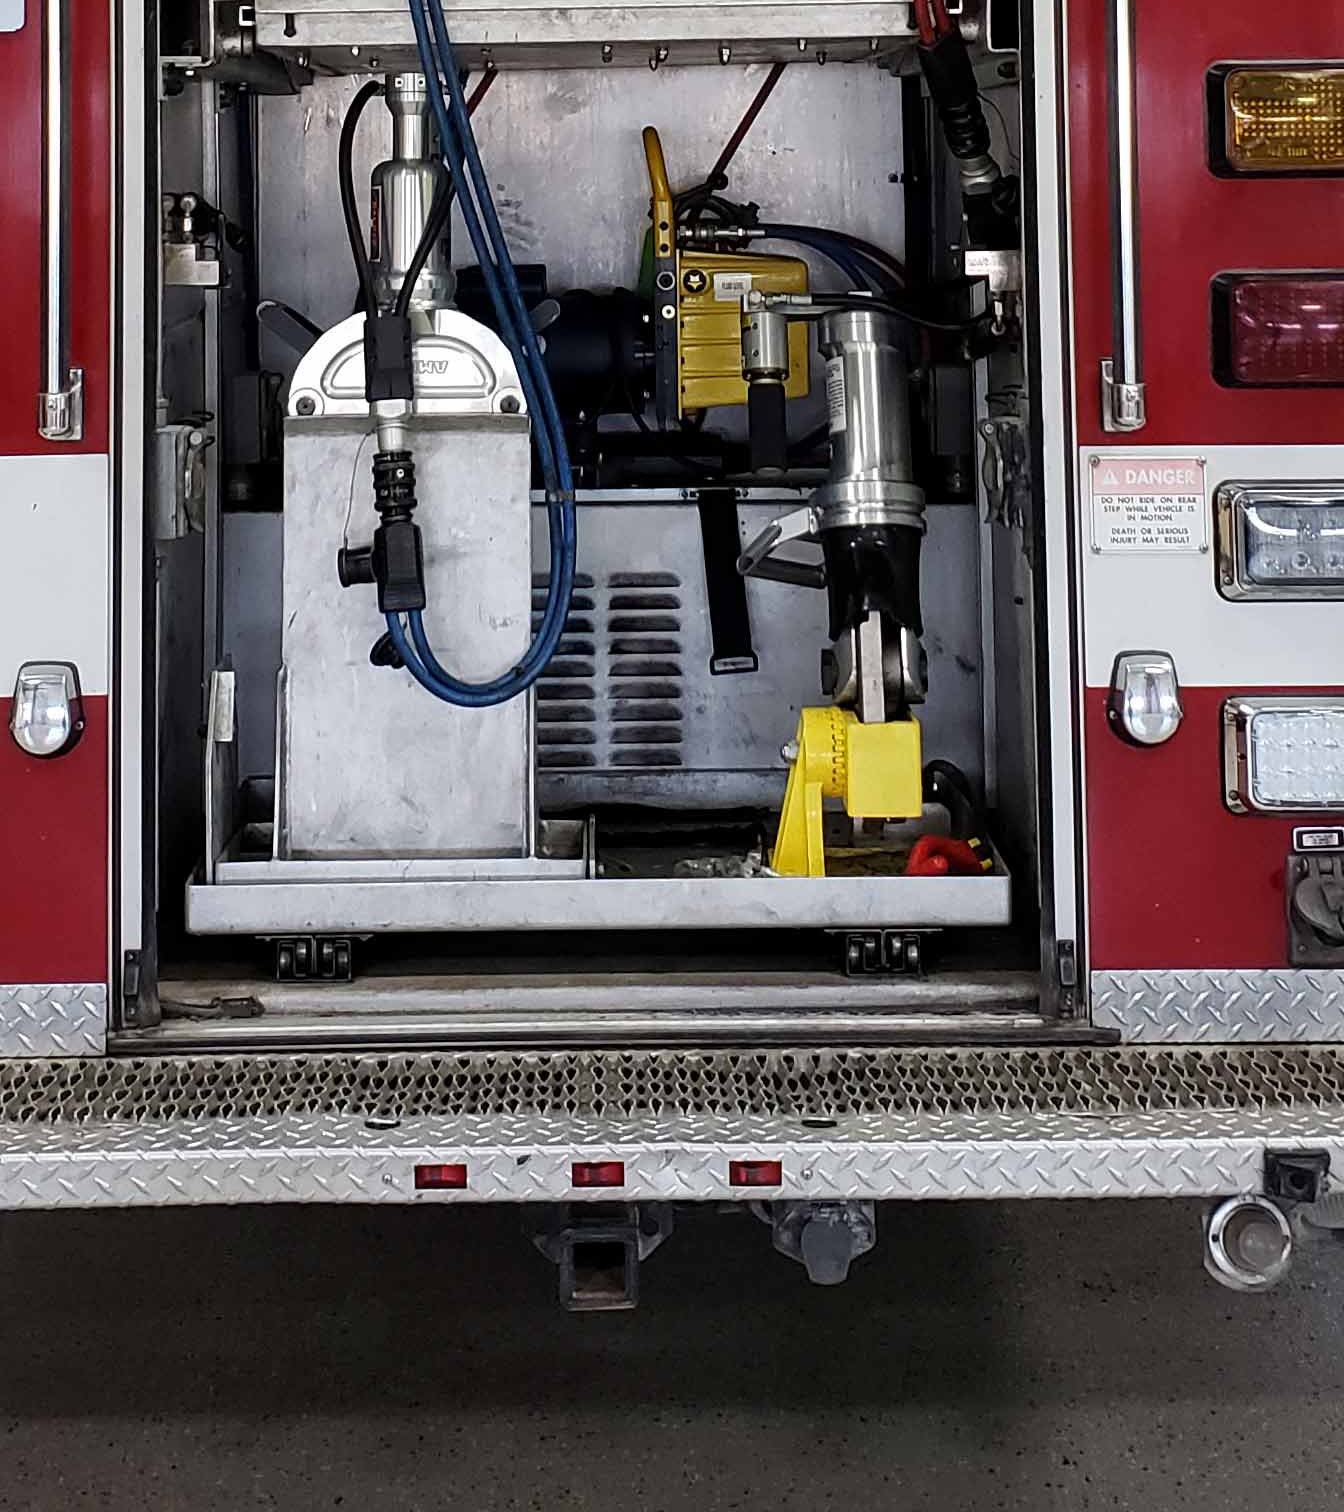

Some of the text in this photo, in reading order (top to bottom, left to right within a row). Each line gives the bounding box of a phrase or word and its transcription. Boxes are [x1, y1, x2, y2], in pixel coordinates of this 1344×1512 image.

[1125, 469, 1196, 486] DANGER
[1101, 496, 1197, 504] DO NOT RIDE ON REAR
[1103, 505, 1195, 513] STEP WHILE VEHICLE IS
[1127, 513, 1136, 522] IN
[1111, 527, 1189, 535] DEATH OR SERIOUS
[1110, 536, 1190, 544] INJURY MAY RESULT
